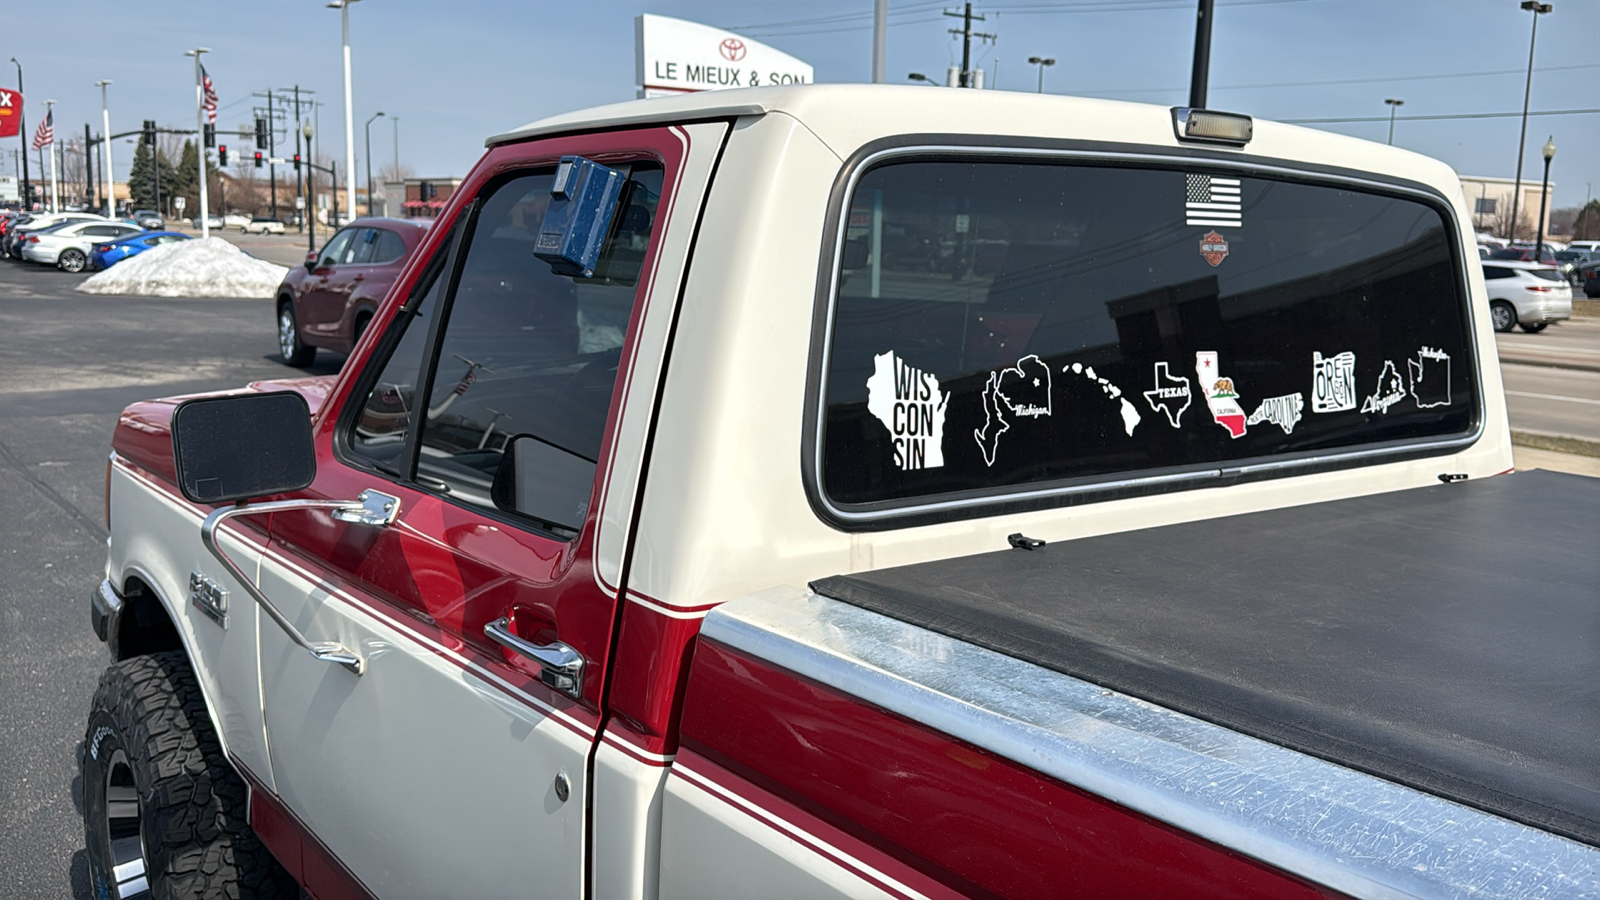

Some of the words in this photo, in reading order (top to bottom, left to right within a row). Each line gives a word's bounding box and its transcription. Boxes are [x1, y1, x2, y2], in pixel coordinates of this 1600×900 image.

[655, 61, 678, 80] LE
[686, 64, 741, 86] MIEUX
[749, 70, 761, 87] &
[1158, 386, 1188, 399] TEXAS
[1014, 403, 1048, 419] Michigan
